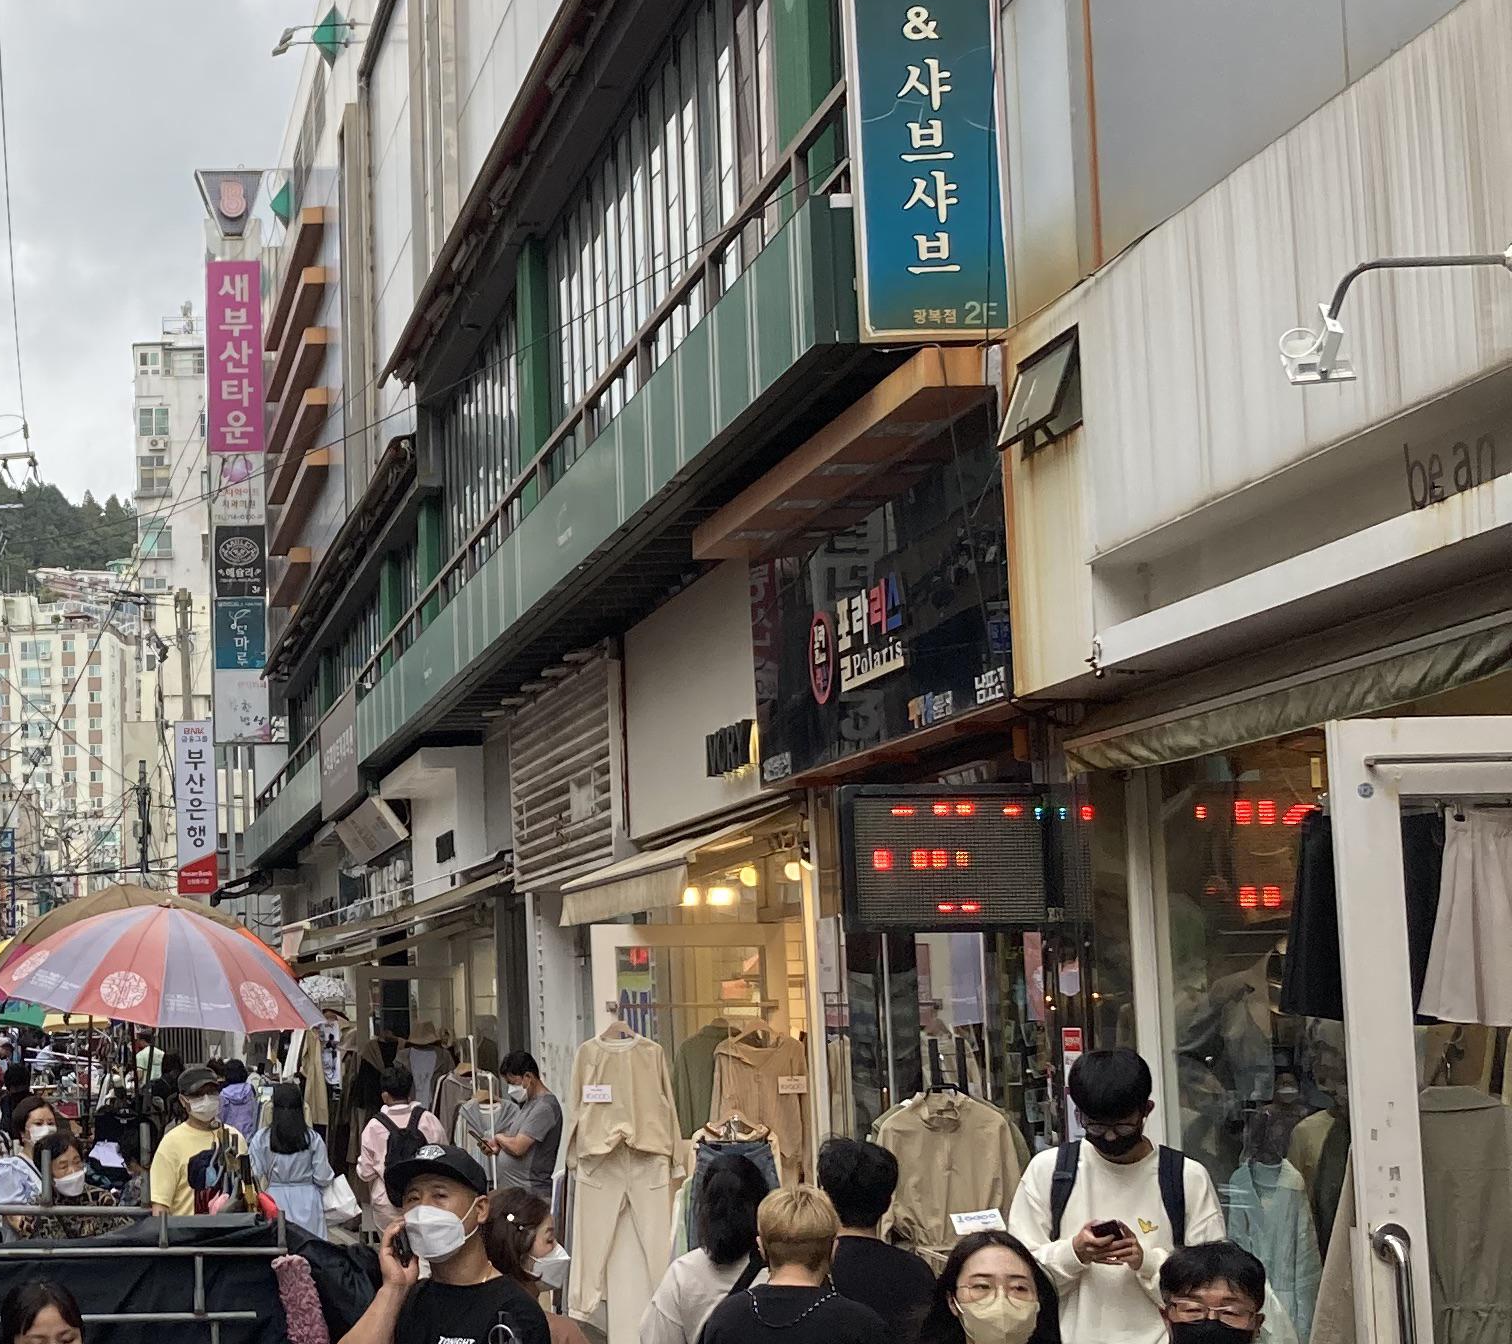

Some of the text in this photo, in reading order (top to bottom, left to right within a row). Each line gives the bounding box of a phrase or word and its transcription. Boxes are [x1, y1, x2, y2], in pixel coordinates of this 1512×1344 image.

[217, 273, 255, 445] 새부산타운
[912, 301, 999, 325] 광복점 2F
[836, 571, 905, 694] 폴라리스
[851, 635, 903, 678] Polaris
[184, 749, 207, 848] 부산은행
